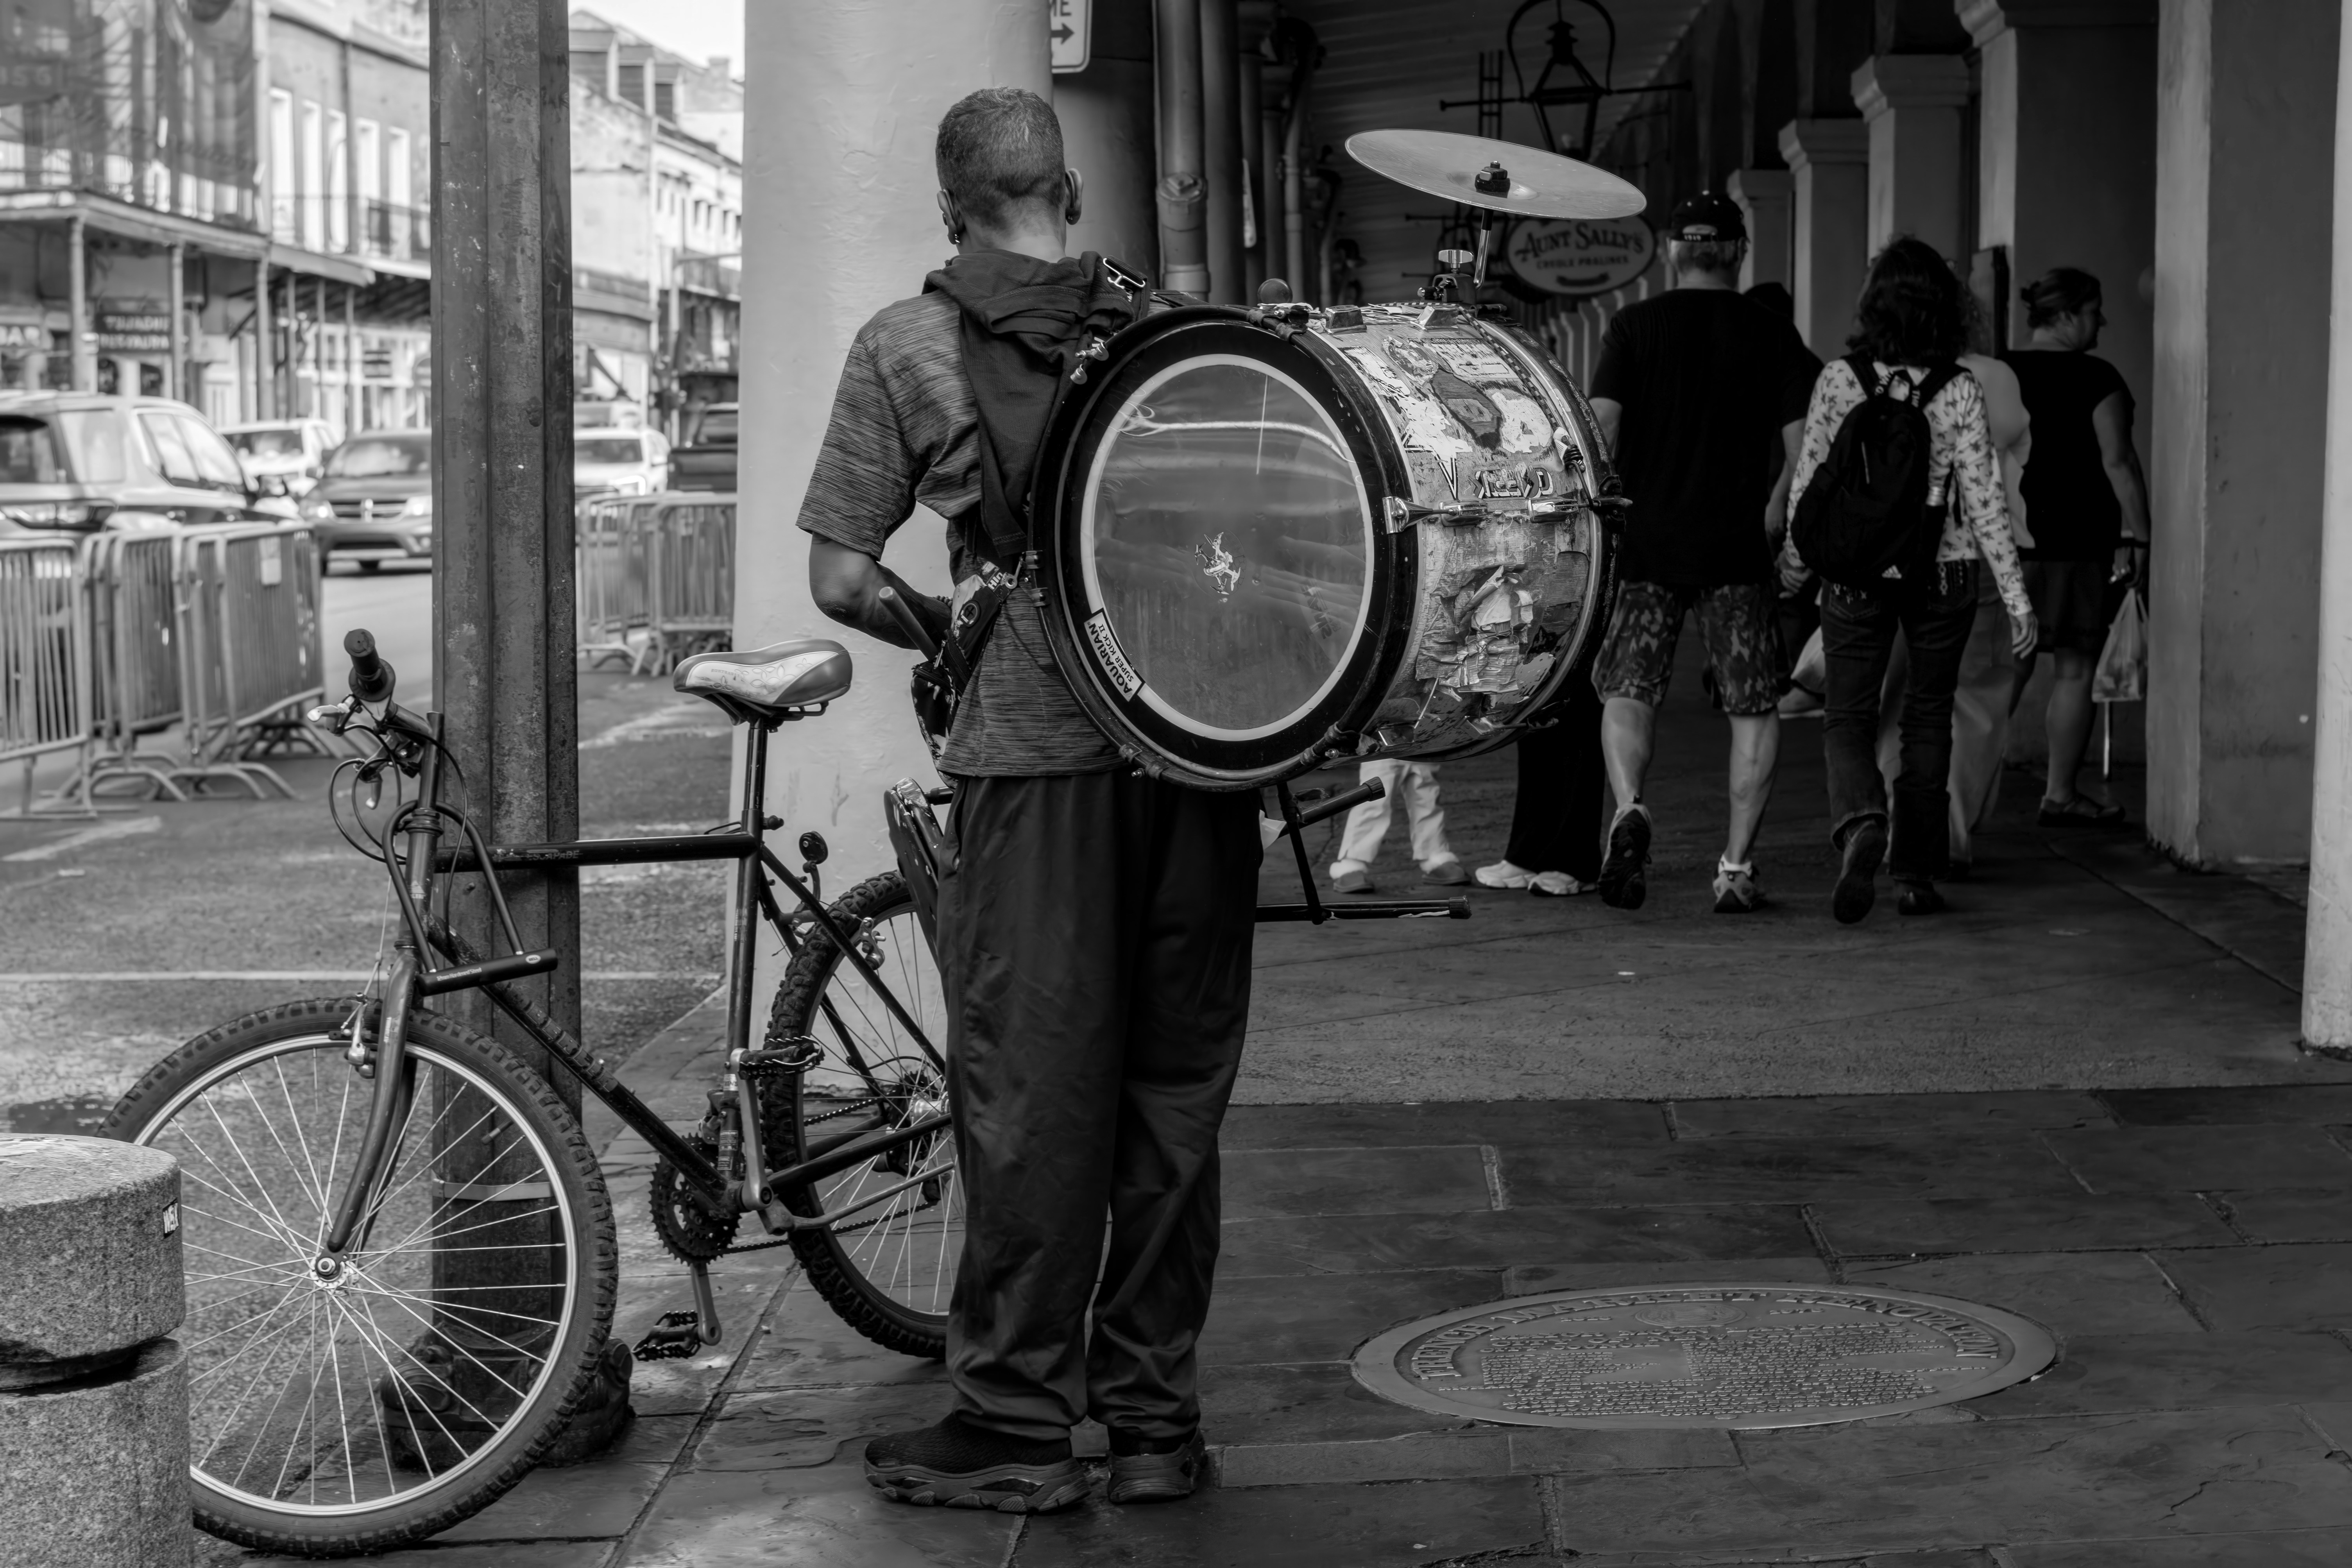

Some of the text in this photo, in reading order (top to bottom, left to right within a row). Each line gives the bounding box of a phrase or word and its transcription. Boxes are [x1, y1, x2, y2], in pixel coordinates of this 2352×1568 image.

[1514, 222, 1644, 262] AUNT SALLY'S
[1103, 634, 1117, 655] KICK
[1115, 656, 1134, 682] SUPER
[1411, 1291, 2000, 1380] FRENCH MARKET RENOVATION
[1490, 1332, 1605, 1341] MAYOR
[1726, 1321, 1905, 1333] LANDRIEU
[1747, 1327, 1909, 1338] ORLEANS
